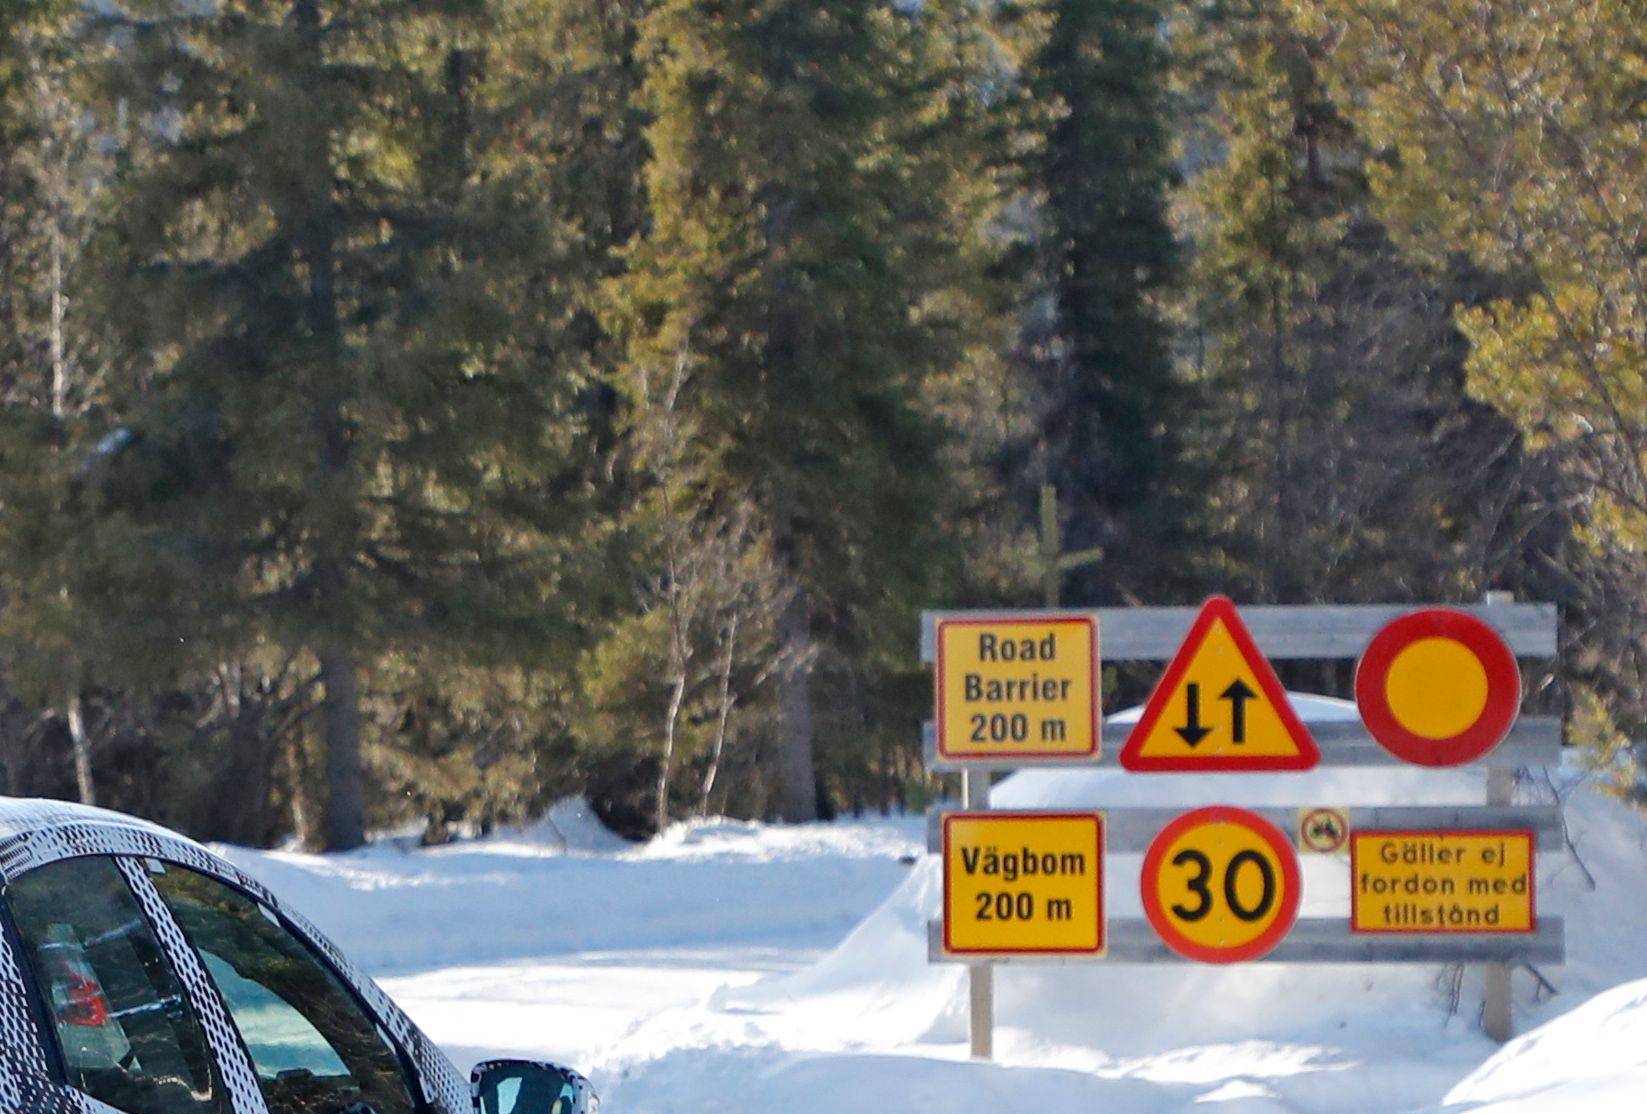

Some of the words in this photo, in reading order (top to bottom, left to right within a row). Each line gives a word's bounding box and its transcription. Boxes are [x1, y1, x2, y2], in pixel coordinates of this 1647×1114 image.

[979, 632, 1056, 662] Road
[965, 673, 1071, 701] Barrier
[970, 713, 1029, 742] 200
[1041, 719, 1066, 741] m
[961, 846, 1086, 882] Vägbom
[1381, 842, 1466, 866] Gäller
[1481, 842, 1505, 867] ej
[1170, 848, 1276, 923] 30
[1361, 873, 1455, 894] fordon
[1469, 872, 1527, 894] med
[976, 892, 1034, 921] 200
[1047, 898, 1072, 920] m
[1384, 903, 1499, 926] tillstånd
